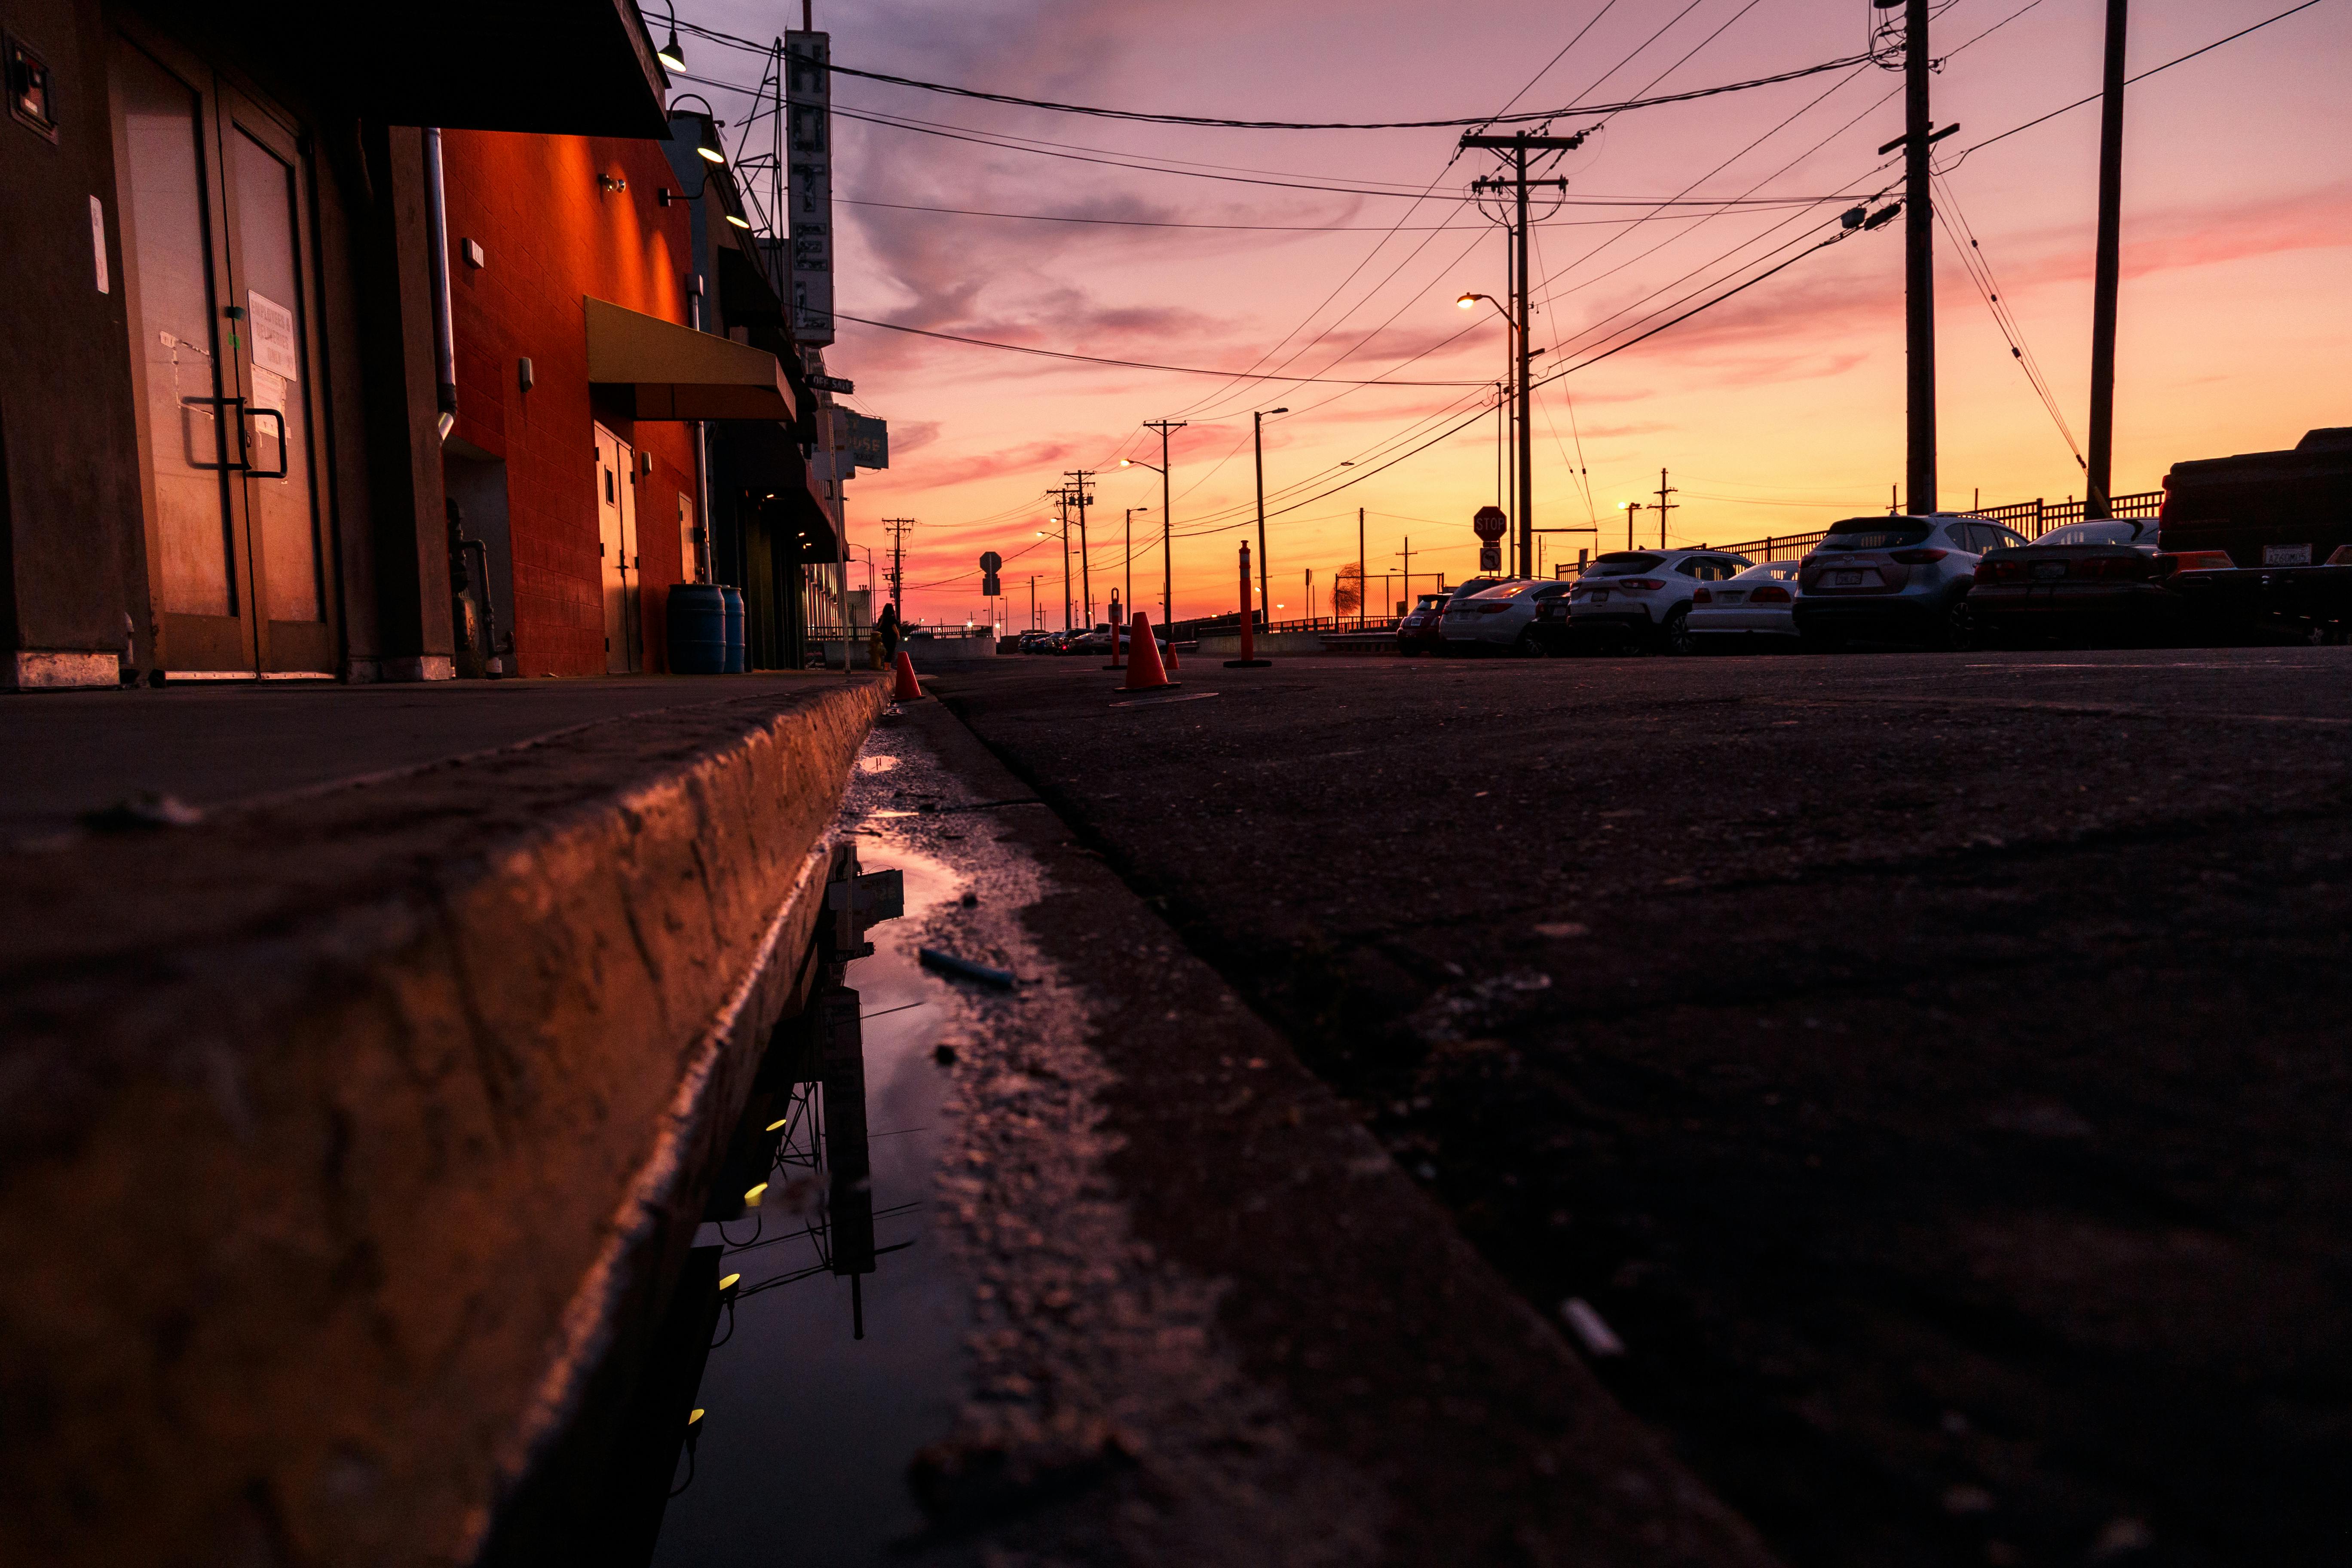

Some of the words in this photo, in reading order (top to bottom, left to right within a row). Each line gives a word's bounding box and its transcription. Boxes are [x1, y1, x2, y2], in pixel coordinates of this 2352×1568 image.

[791, 44, 828, 330] HOTEL
[251, 299, 285, 330] EMPLOYEES
[267, 347, 281, 365] ONLY
[813, 375, 829, 387] OFF
[1476, 517, 1505, 531] STOP
